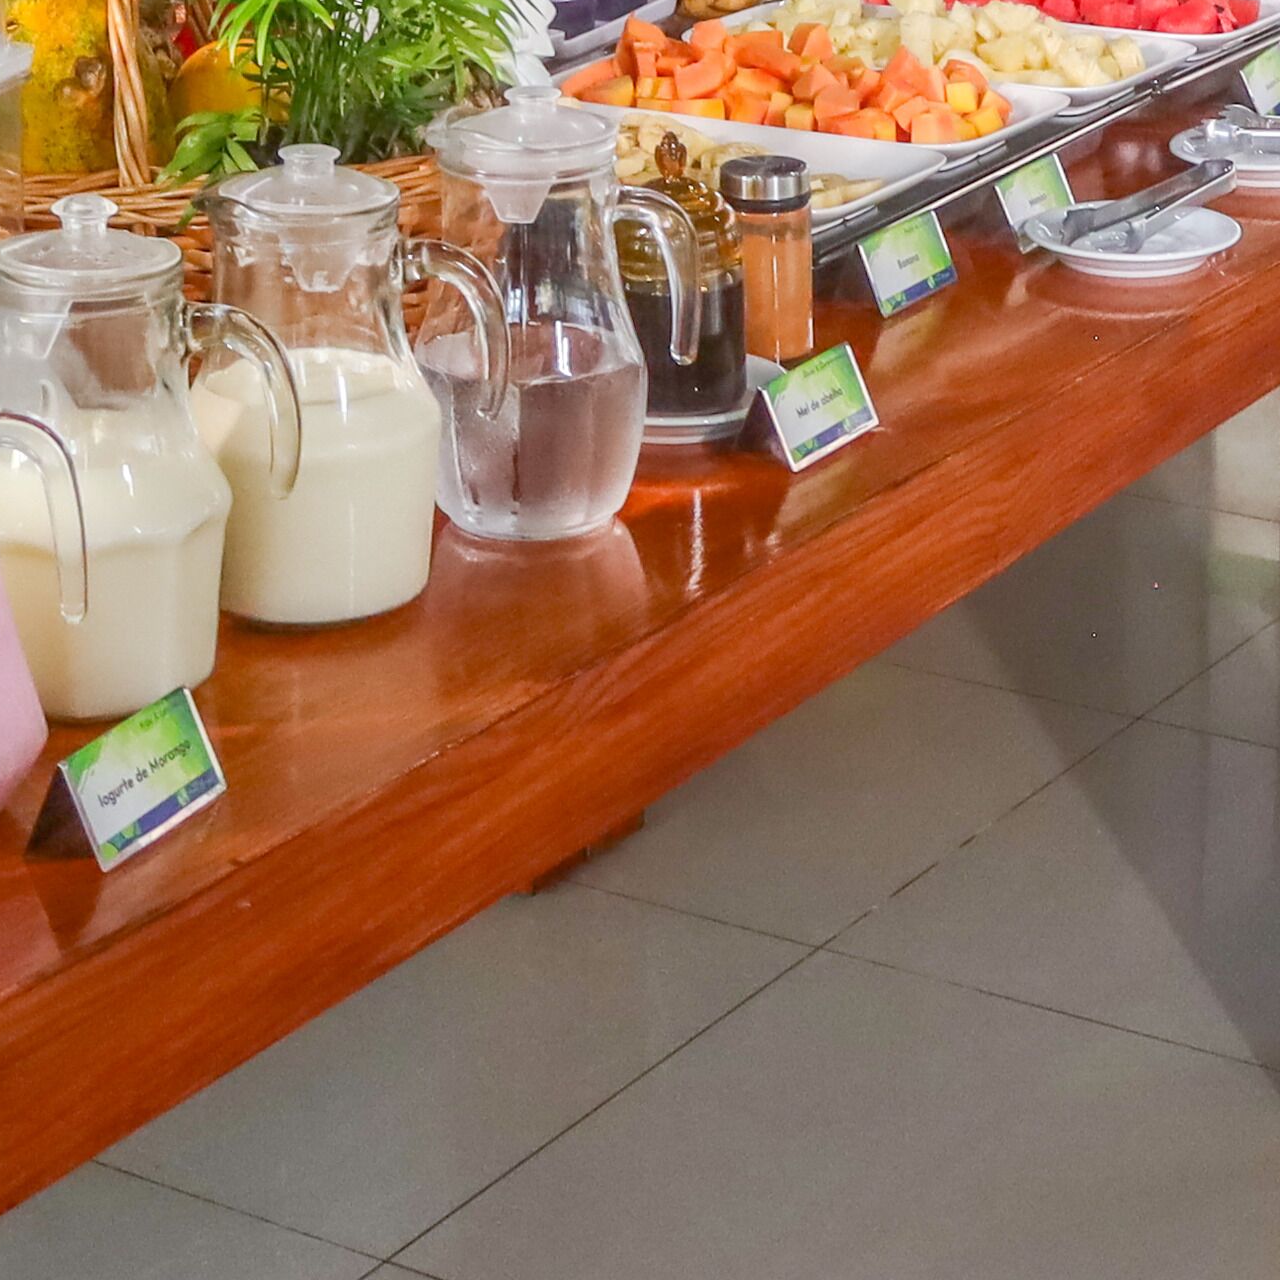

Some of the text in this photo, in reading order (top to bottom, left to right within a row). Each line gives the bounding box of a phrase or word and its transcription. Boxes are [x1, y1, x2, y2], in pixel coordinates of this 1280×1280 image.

[97, 739, 192, 809] Iogurte de Morango
